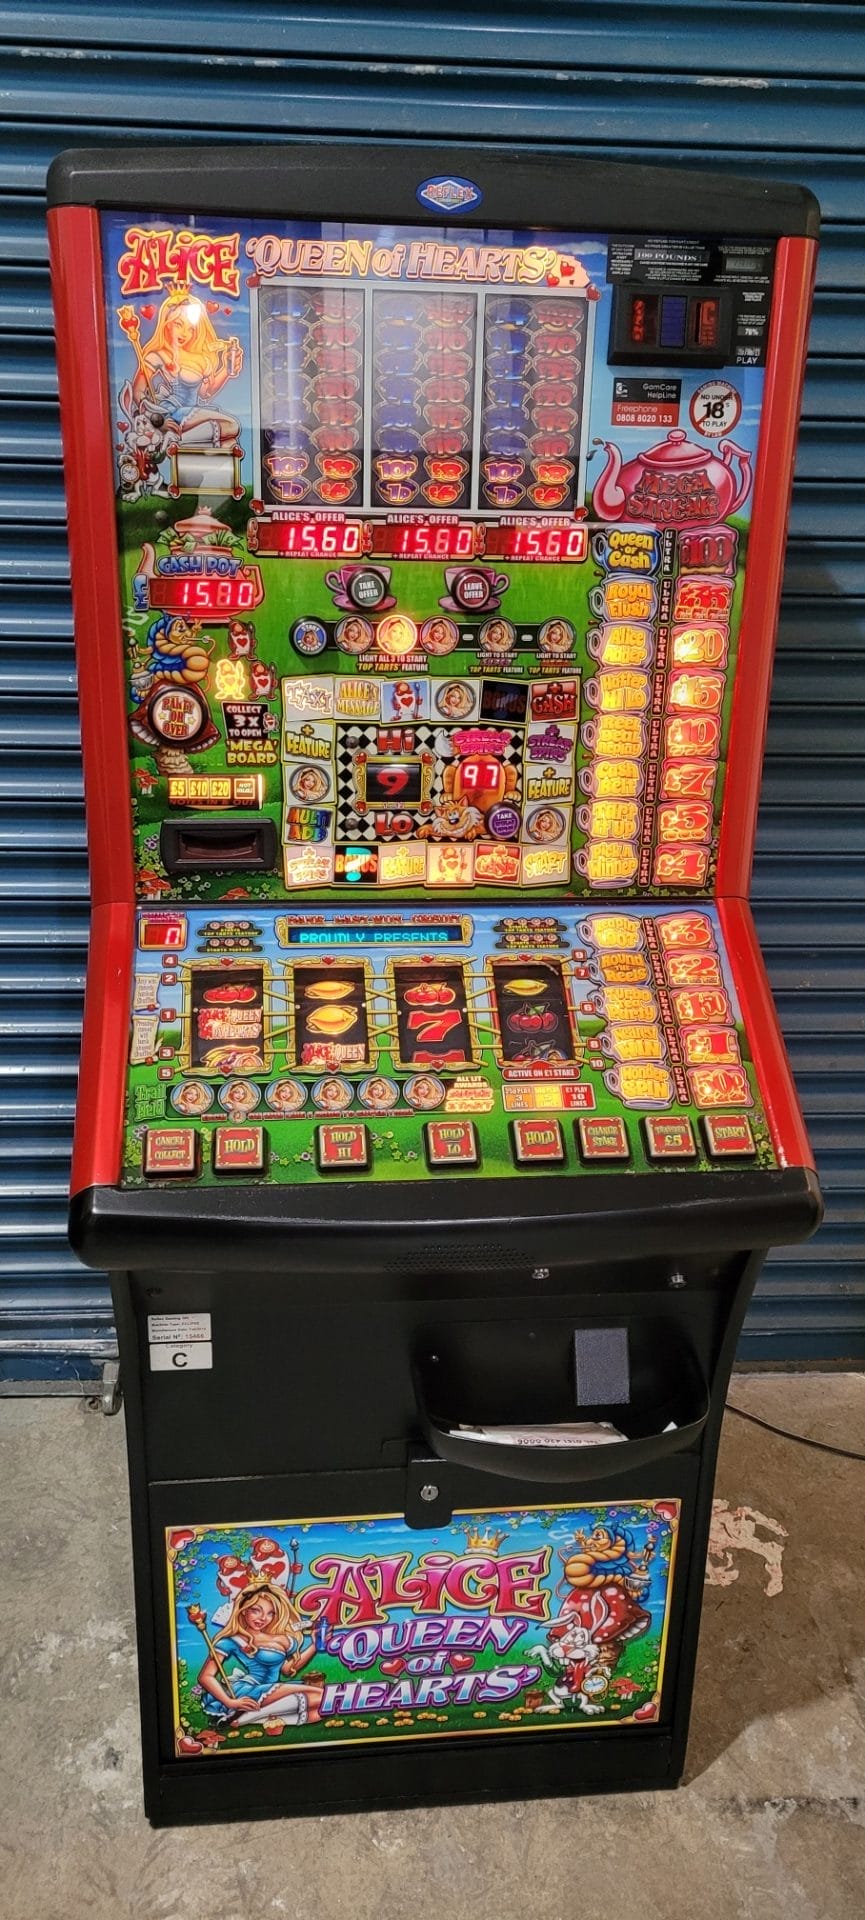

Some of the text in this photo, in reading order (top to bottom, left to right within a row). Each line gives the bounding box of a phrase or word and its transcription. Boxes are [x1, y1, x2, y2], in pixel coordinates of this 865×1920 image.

[427, 185, 475, 200] REFLEX
[372, 245, 405, 278] of
[654, 251, 698, 261] POUNDS
[118, 227, 240, 297] ALICE
[736, 357, 758, 365] PLAY
[643, 383, 677, 392] GamCare
[647, 391, 677, 400] HelpLine
[617, 405, 658, 414] Freephone
[616, 414, 673, 423] 0808 8020 133
[635, 469, 715, 494] MEGA
[626, 493, 719, 522] STREAK
[272, 512, 346, 523] ALICE'S OFFER
[387, 514, 459, 524] ALICE'S OFFER
[500, 516, 571, 526] ALICE'S OFFER
[288, 525, 359, 552] 15.60
[608, 530, 654, 550] Queen
[608, 551, 651, 569] Cash
[157, 556, 243, 577] CASH POT
[359, 581, 376, 590] TAKE
[463, 582, 483, 591] LEAVE
[358, 589, 379, 599] OFFER
[463, 590, 484, 599] OFFER
[606, 583, 653, 602] Royal
[609, 627, 645, 646] Alice
[359, 654, 378, 663] LIGHT
[379, 655, 390, 663] ALL
[397, 655, 406, 663] TO
[407, 655, 428, 663] START
[401, 663, 429, 671] FEATURE
[340, 680, 379, 699] ALICE'S
[531, 694, 577, 713] CASH
[226, 705, 262, 714] COLLECT
[228, 729, 262, 737] TO OPEN
[286, 731, 332, 760] FEATURE
[226, 752, 278, 764] BOARD
[464, 764, 498, 787] 97
[664, 764, 717, 796] £7
[376, 768, 410, 796] 9
[170, 780, 230, 797] £5 £10 £20
[528, 778, 572, 799] FEATURE
[497, 812, 513, 820] TAKE
[660, 804, 709, 831] £5
[523, 850, 568, 878] START
[657, 849, 706, 880] £4
[165, 927, 180, 945] 0
[660, 917, 711, 945] £3
[166, 957, 176, 965] 4
[578, 968, 586, 976] 7
[165, 974, 175, 983] 2
[163, 1010, 172, 1020] 1
[162, 1048, 172, 1057] 3
[590, 1059, 603, 1067] 10
[161, 1069, 171, 1078] 5
[508, 1070, 533, 1078] ACTIVE
[533, 1070, 544, 1078] ON
[553, 1069, 575, 1077] STAKE
[573, 1086, 588, 1094] PLAY
[438, 1128, 465, 1140] HOLD
[588, 1126, 618, 1136] CHANGE
[715, 1127, 746, 1138] START
[155, 1136, 185, 1145] CANCEL
[331, 1131, 357, 1143] HOLD
[524, 1131, 555, 1145] HOLD
[592, 1136, 617, 1146] STAKE
[664, 1134, 683, 1146] £5
[224, 1139, 255, 1153] HOLD
[447, 1144, 461, 1153] LO
[154, 1150, 186, 1160] COLLECT
[338, 1147, 352, 1158] HI
[171, 1352, 188, 1368] C
[301, 1546, 553, 1628] ALICE
[406, 1650, 448, 1675] of
